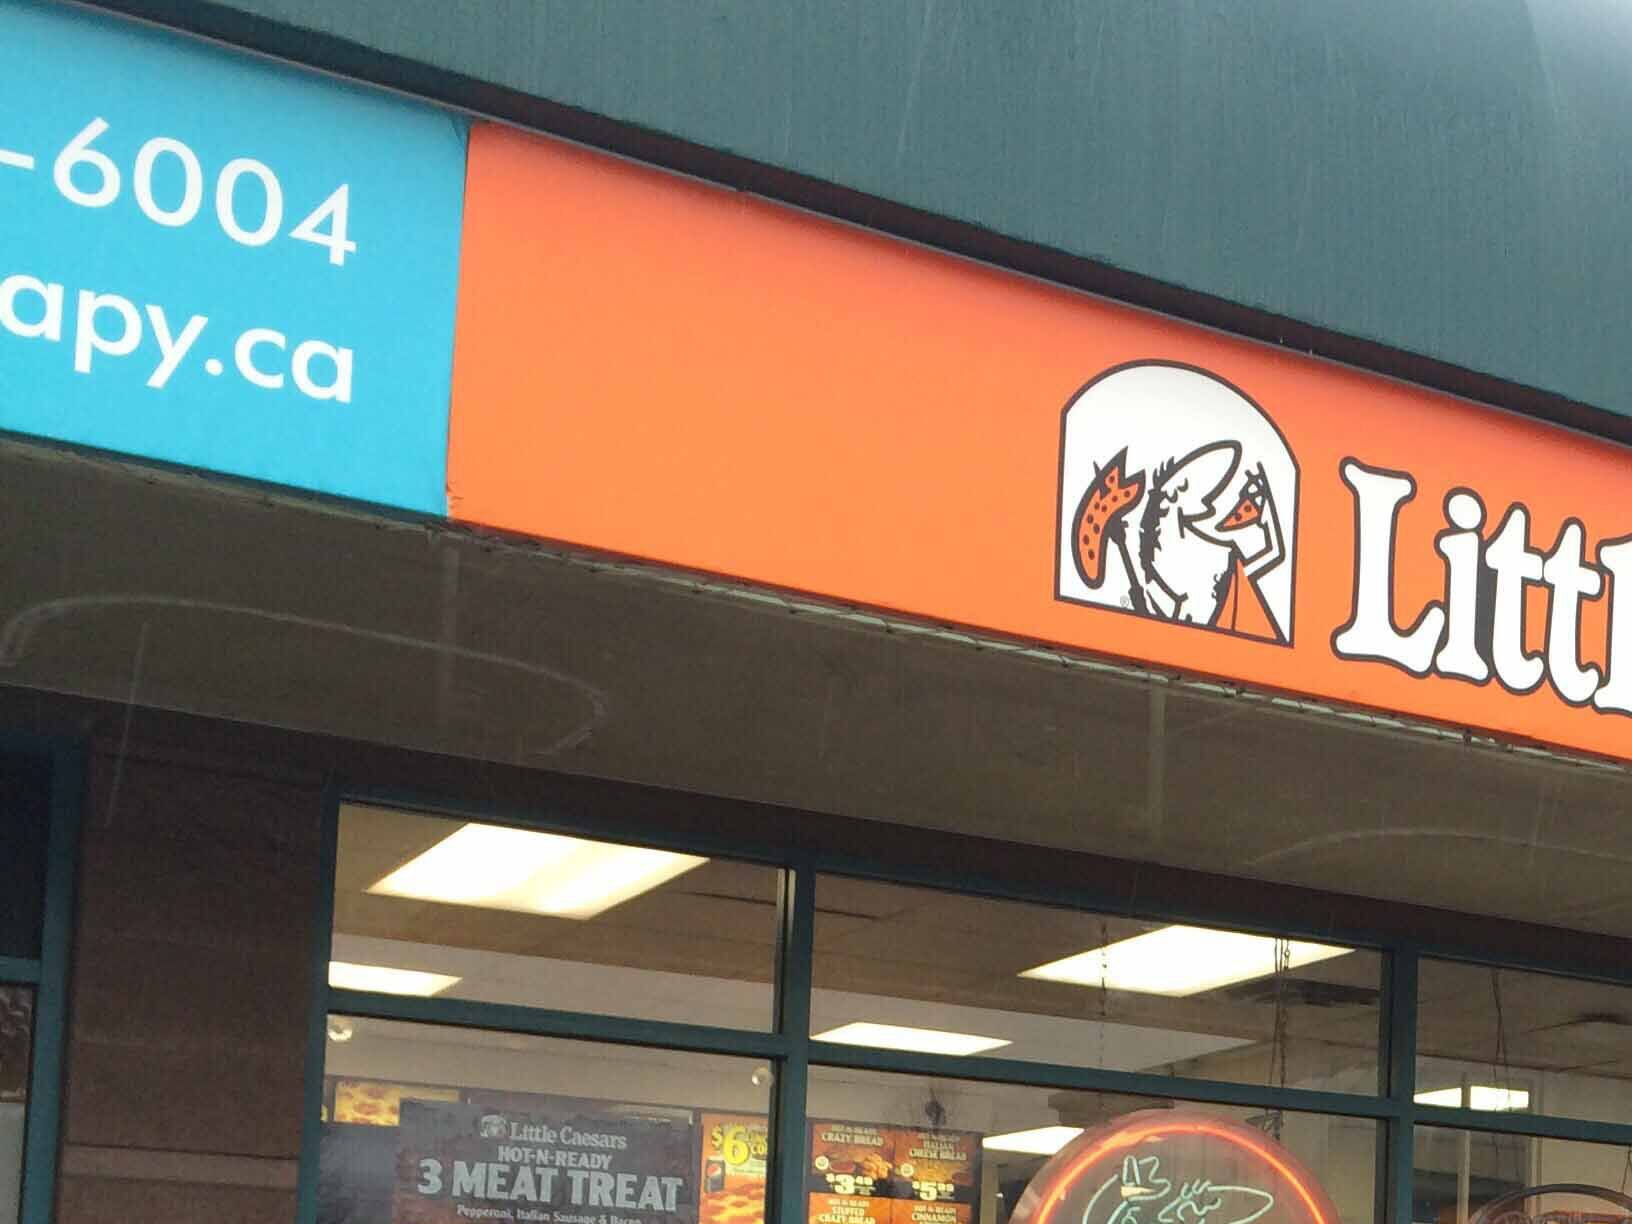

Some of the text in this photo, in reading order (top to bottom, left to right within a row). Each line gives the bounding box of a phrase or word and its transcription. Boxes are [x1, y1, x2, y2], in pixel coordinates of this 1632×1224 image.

[0, 274, 354, 404] apy.ca
[509, 1121, 628, 1149] Little Caesars
[498, 1145, 613, 1170] HOT-N-READY
[416, 1158, 684, 1212] 3 MEAT TREAT
